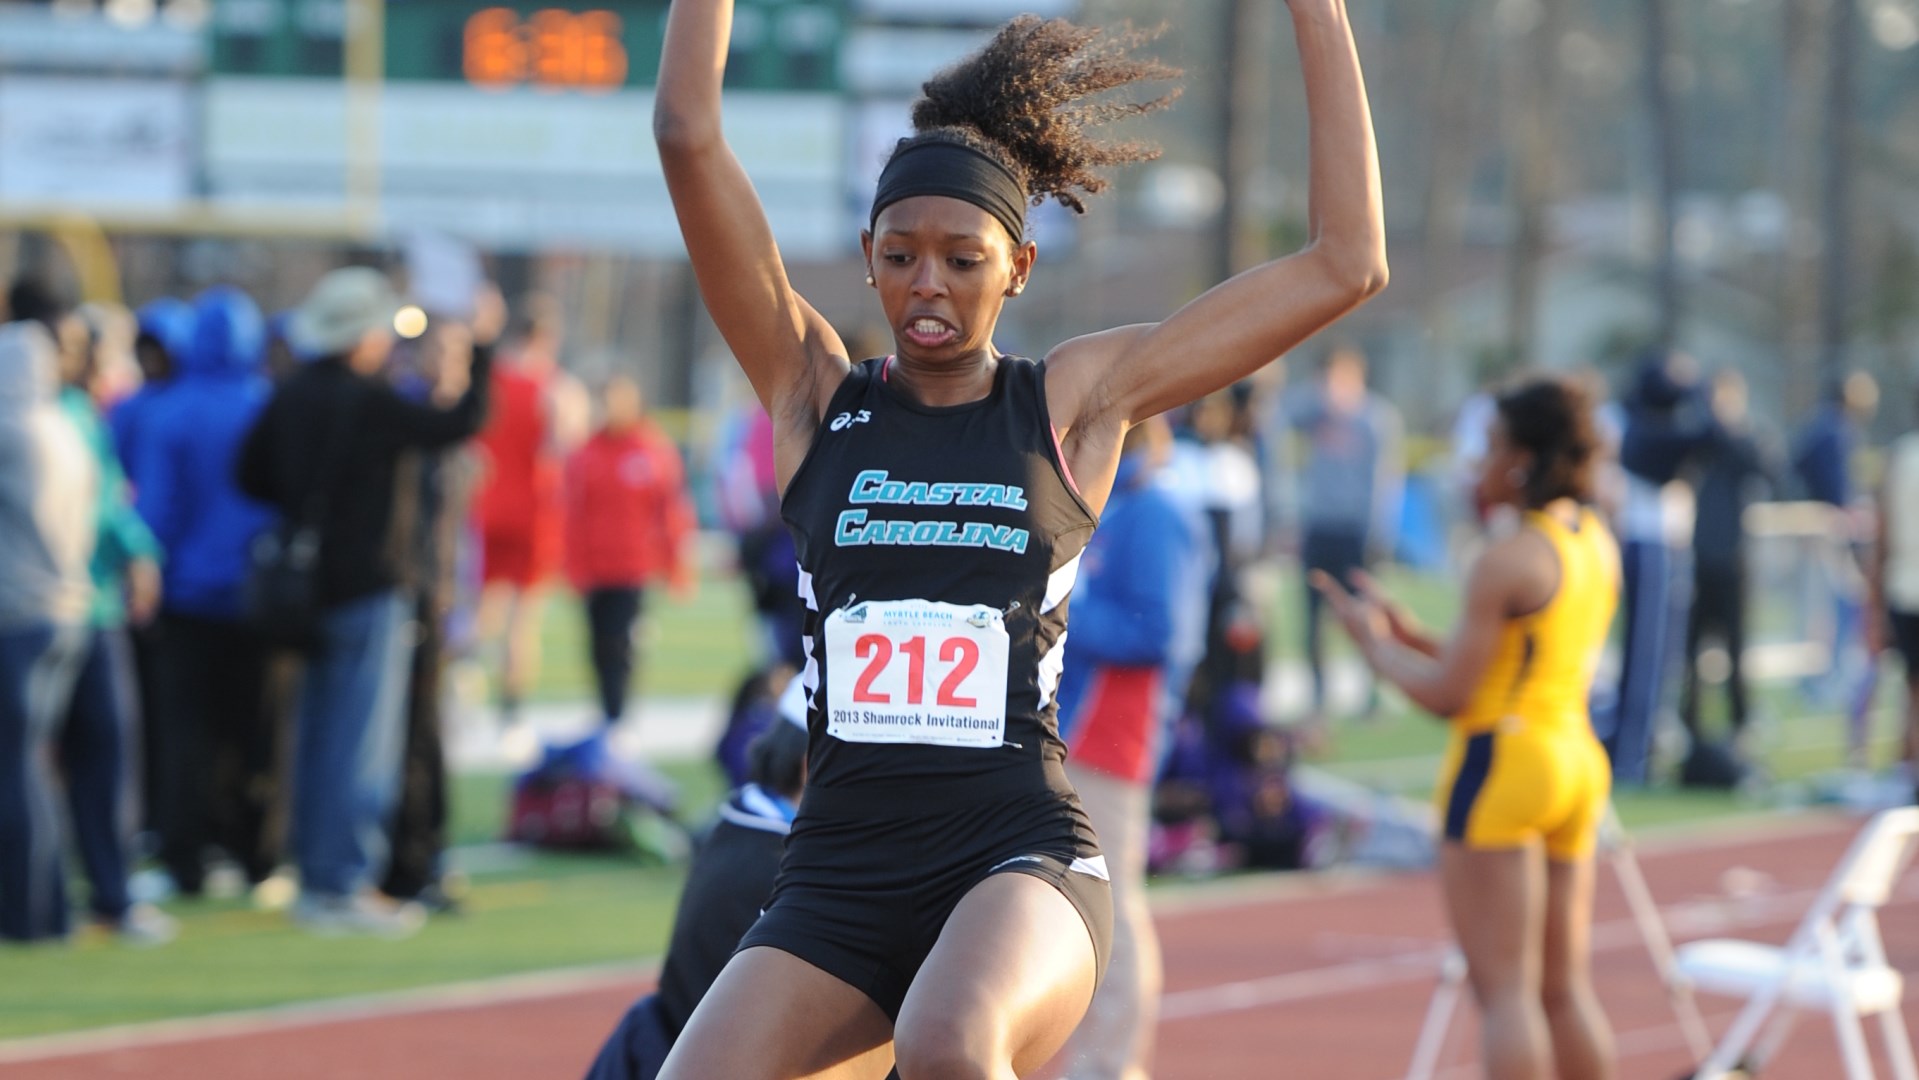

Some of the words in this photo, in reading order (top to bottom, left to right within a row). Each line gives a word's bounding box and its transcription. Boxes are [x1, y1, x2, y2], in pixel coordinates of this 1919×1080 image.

[849, 470, 1028, 511] COASTAL
[835, 509, 1029, 554] CAROLINA
[883, 611, 919, 619] MYRTLE
[922, 611, 953, 620] BEACH
[853, 633, 980, 708] 212
[834, 711, 859, 724] 2013
[863, 713, 921, 727] Shamrock
[927, 714, 999, 730] Invitational
